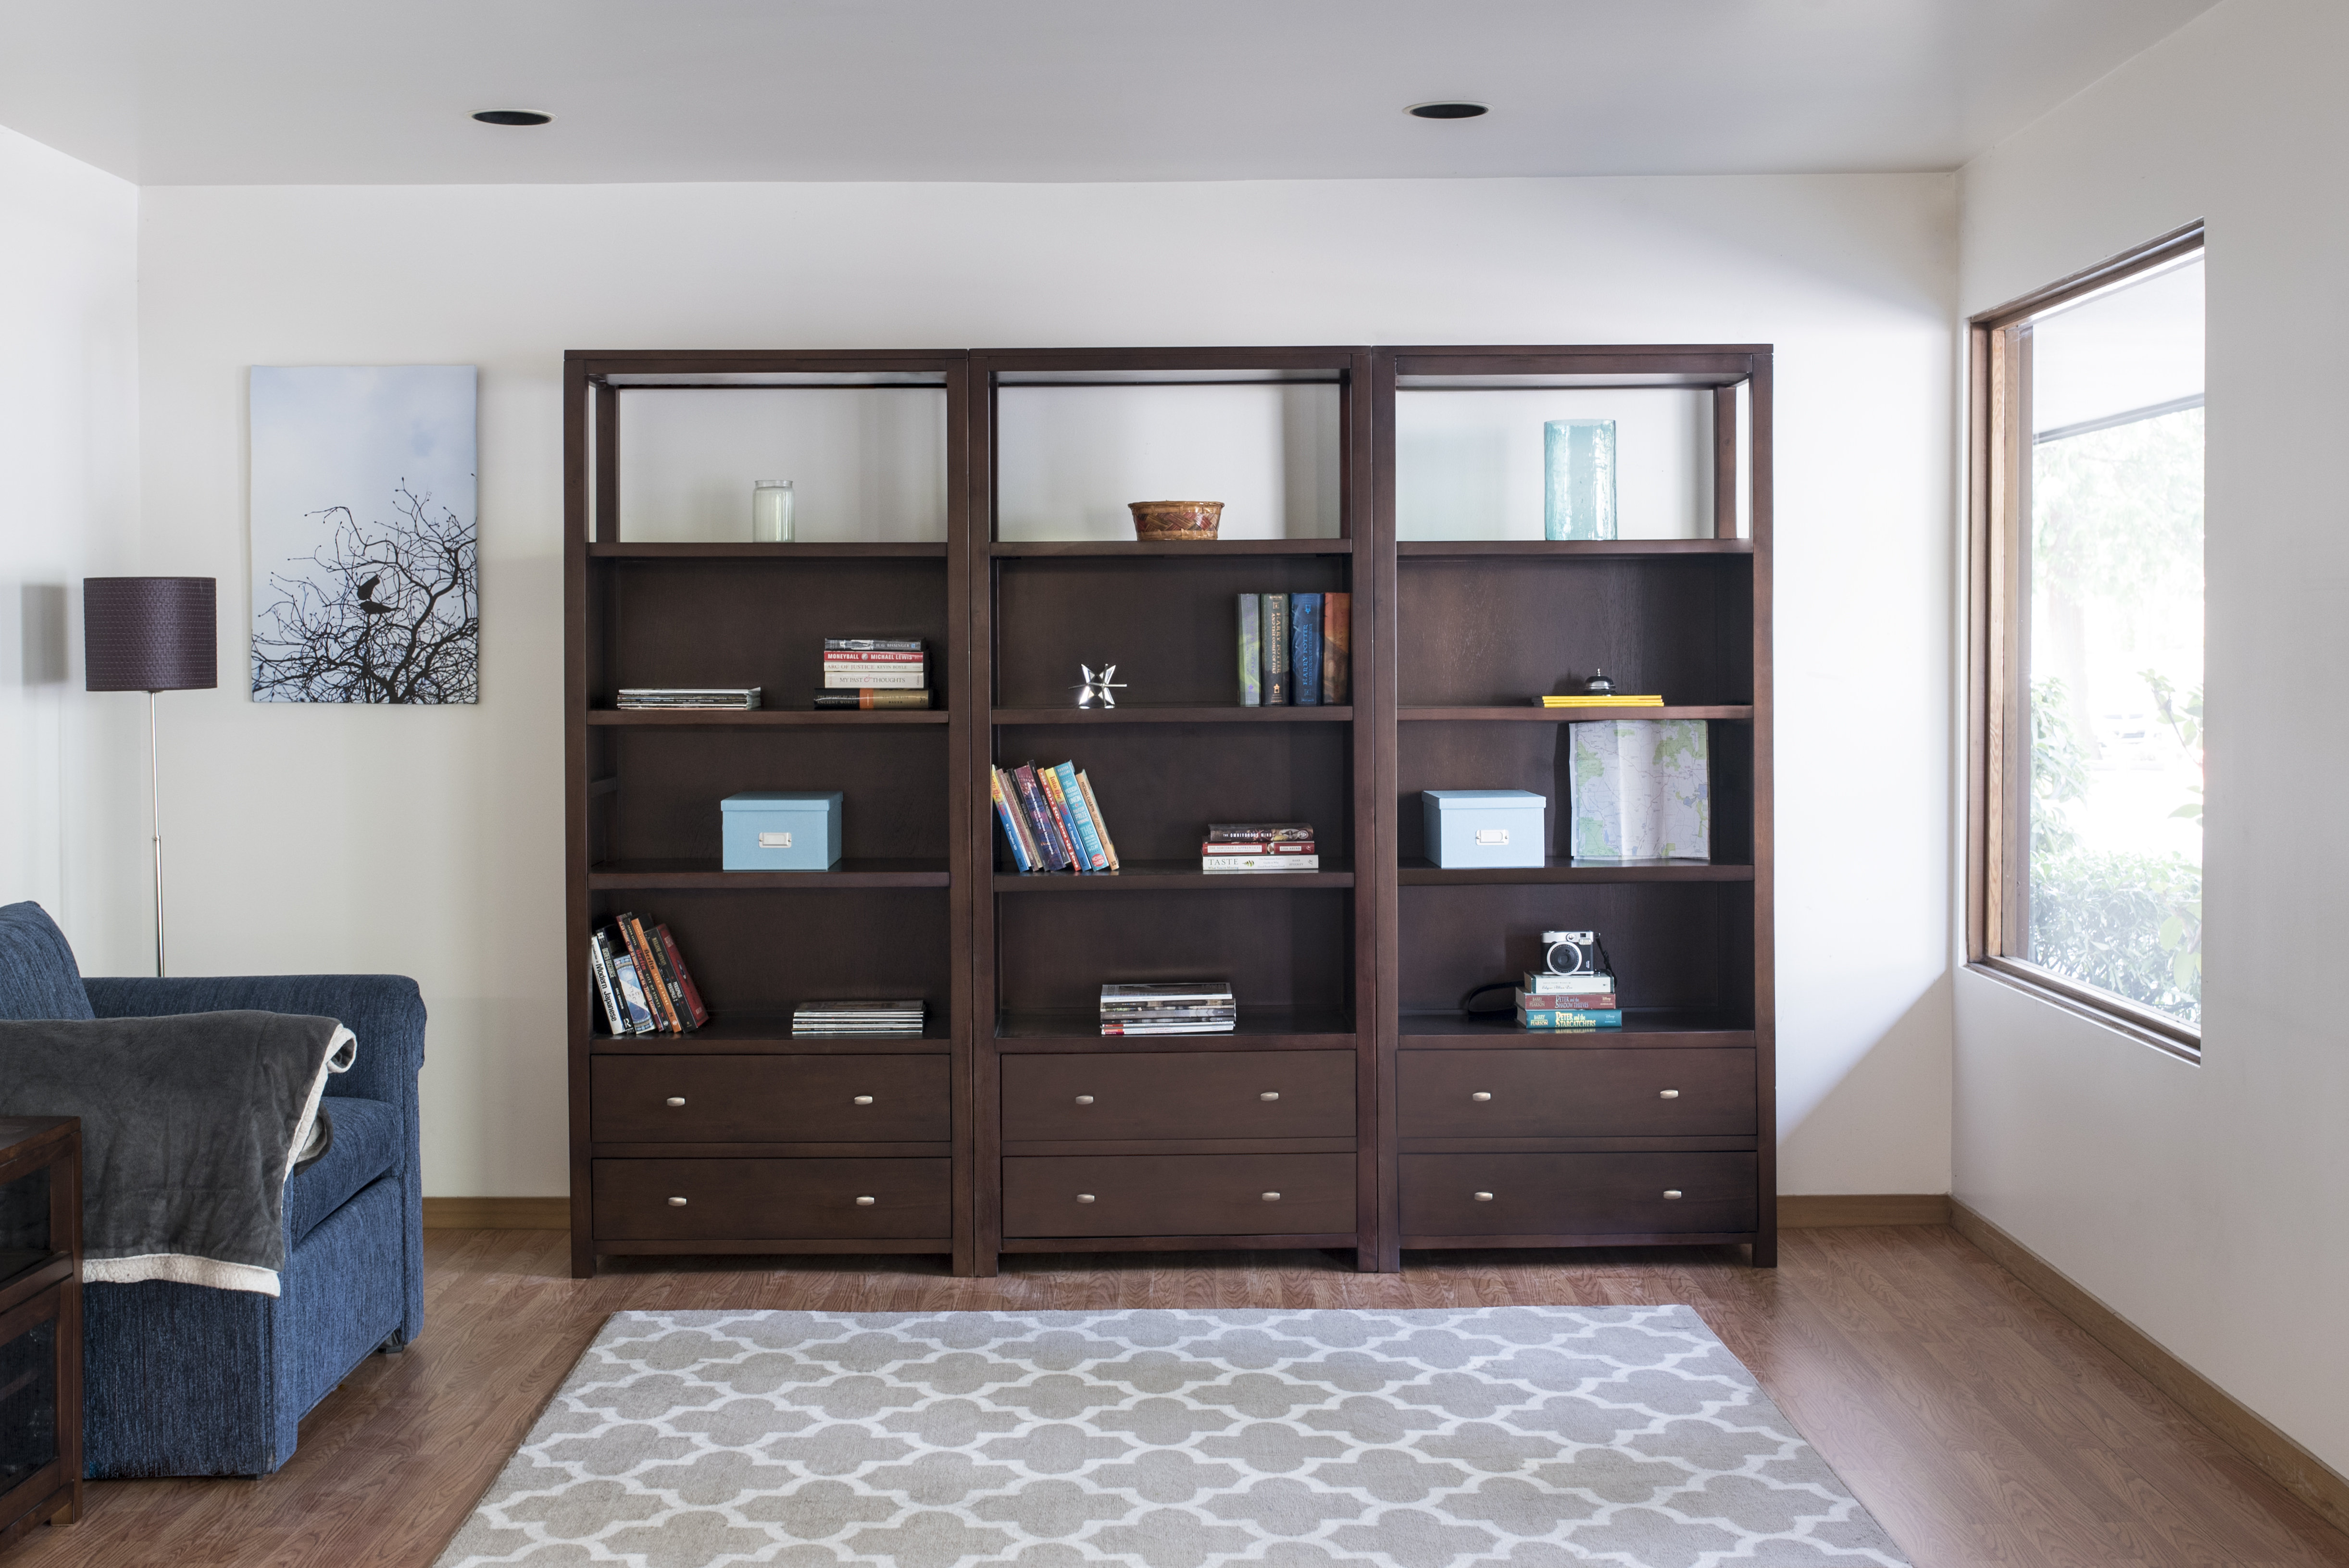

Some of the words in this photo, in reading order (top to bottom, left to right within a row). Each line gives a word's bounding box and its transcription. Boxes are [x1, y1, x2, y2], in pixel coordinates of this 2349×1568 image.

[993, 789, 1001, 800] the
[1050, 776, 1059, 788] Into
[1055, 788, 1063, 800] the
[1069, 795, 1081, 804] UNION
[1081, 781, 1089, 796] MICHAEL
[1087, 796, 1095, 812] CHABON
[1075, 811, 1087, 819] PRIZE
[1080, 825, 1093, 836] THE
[635, 948, 648, 970] Berlin
[643, 948, 656, 970] Berlin
[596, 963, 608, 989] Modern
[603, 990, 617, 1021] Japanese
[667, 983, 676, 999] PERSEPOLIS
[673, 982, 683, 998] PERSEPOLIS
[1555, 1011, 1573, 1020] PETER
[1555, 1019, 1596, 1027] STARCATCHERS
